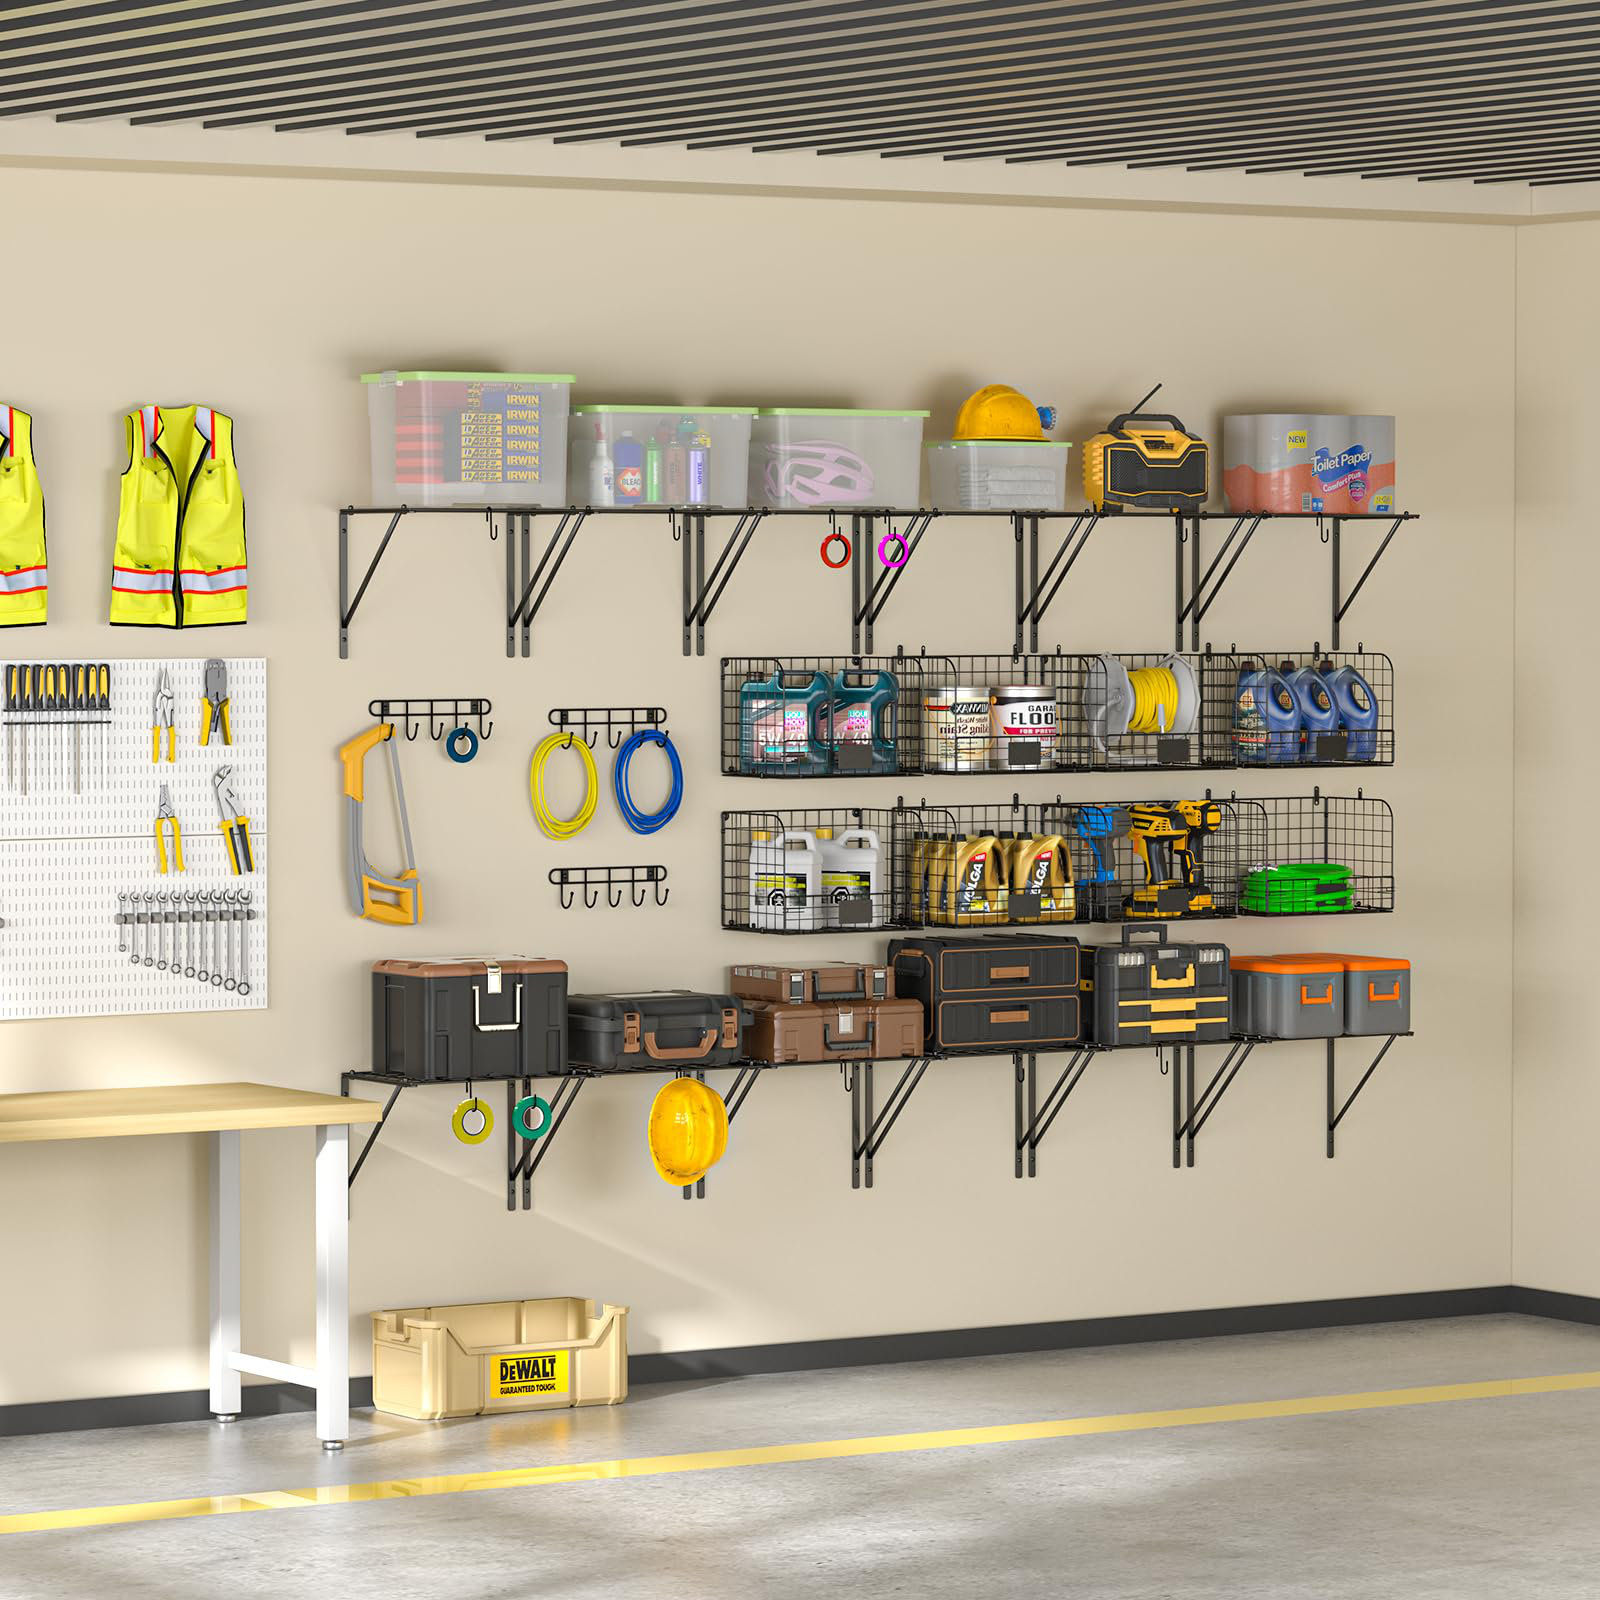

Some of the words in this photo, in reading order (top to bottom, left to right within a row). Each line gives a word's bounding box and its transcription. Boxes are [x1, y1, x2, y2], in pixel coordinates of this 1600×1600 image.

[507, 395, 539, 404] IRWIN
[507, 410, 539, 419] IRWIN
[507, 425, 539, 434] IRWIN
[507, 440, 539, 450] IRWIN
[507, 455, 539, 465] IRWIN
[1310, 456, 1340, 472] Toilet
[1341, 451, 1372, 467] Paper
[507, 471, 539, 480] IRWIN
[1322, 478, 1348, 492] Comfort
[1347, 472, 1361, 481] Plus
[1011, 712, 1056, 725] FLOO
[500, 1358, 556, 1381] DEWALT
[500, 1385, 535, 1394] GUARANTEED
[536, 1383, 556, 1392] TOUGH
